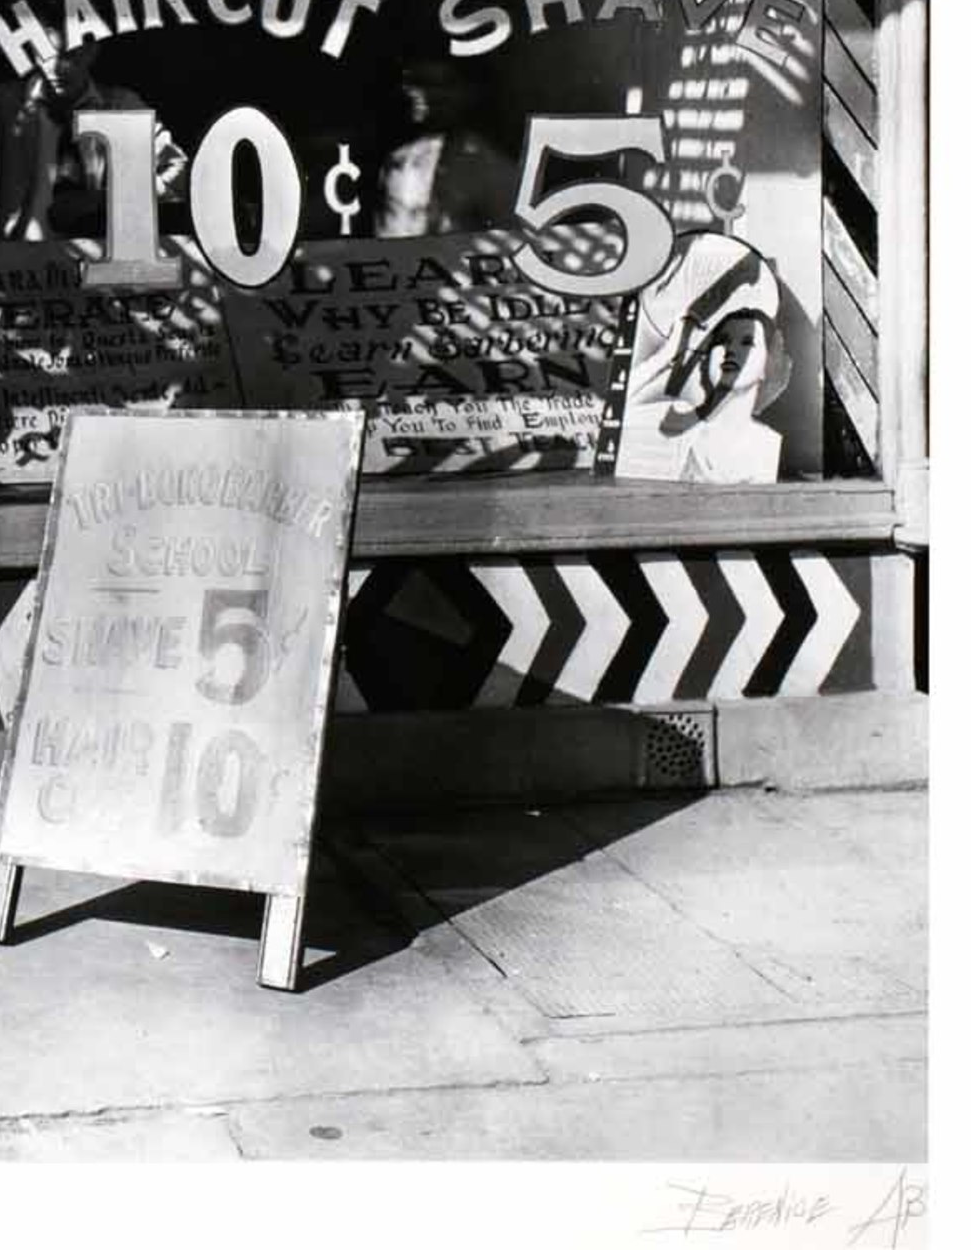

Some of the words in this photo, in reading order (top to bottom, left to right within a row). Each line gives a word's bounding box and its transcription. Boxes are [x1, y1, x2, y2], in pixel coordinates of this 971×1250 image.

[290, 253, 529, 295] LEAR
[311, 352, 592, 401] EARN
[382, 417, 425, 434] You
[105, 525, 269, 579] SCHOOL
